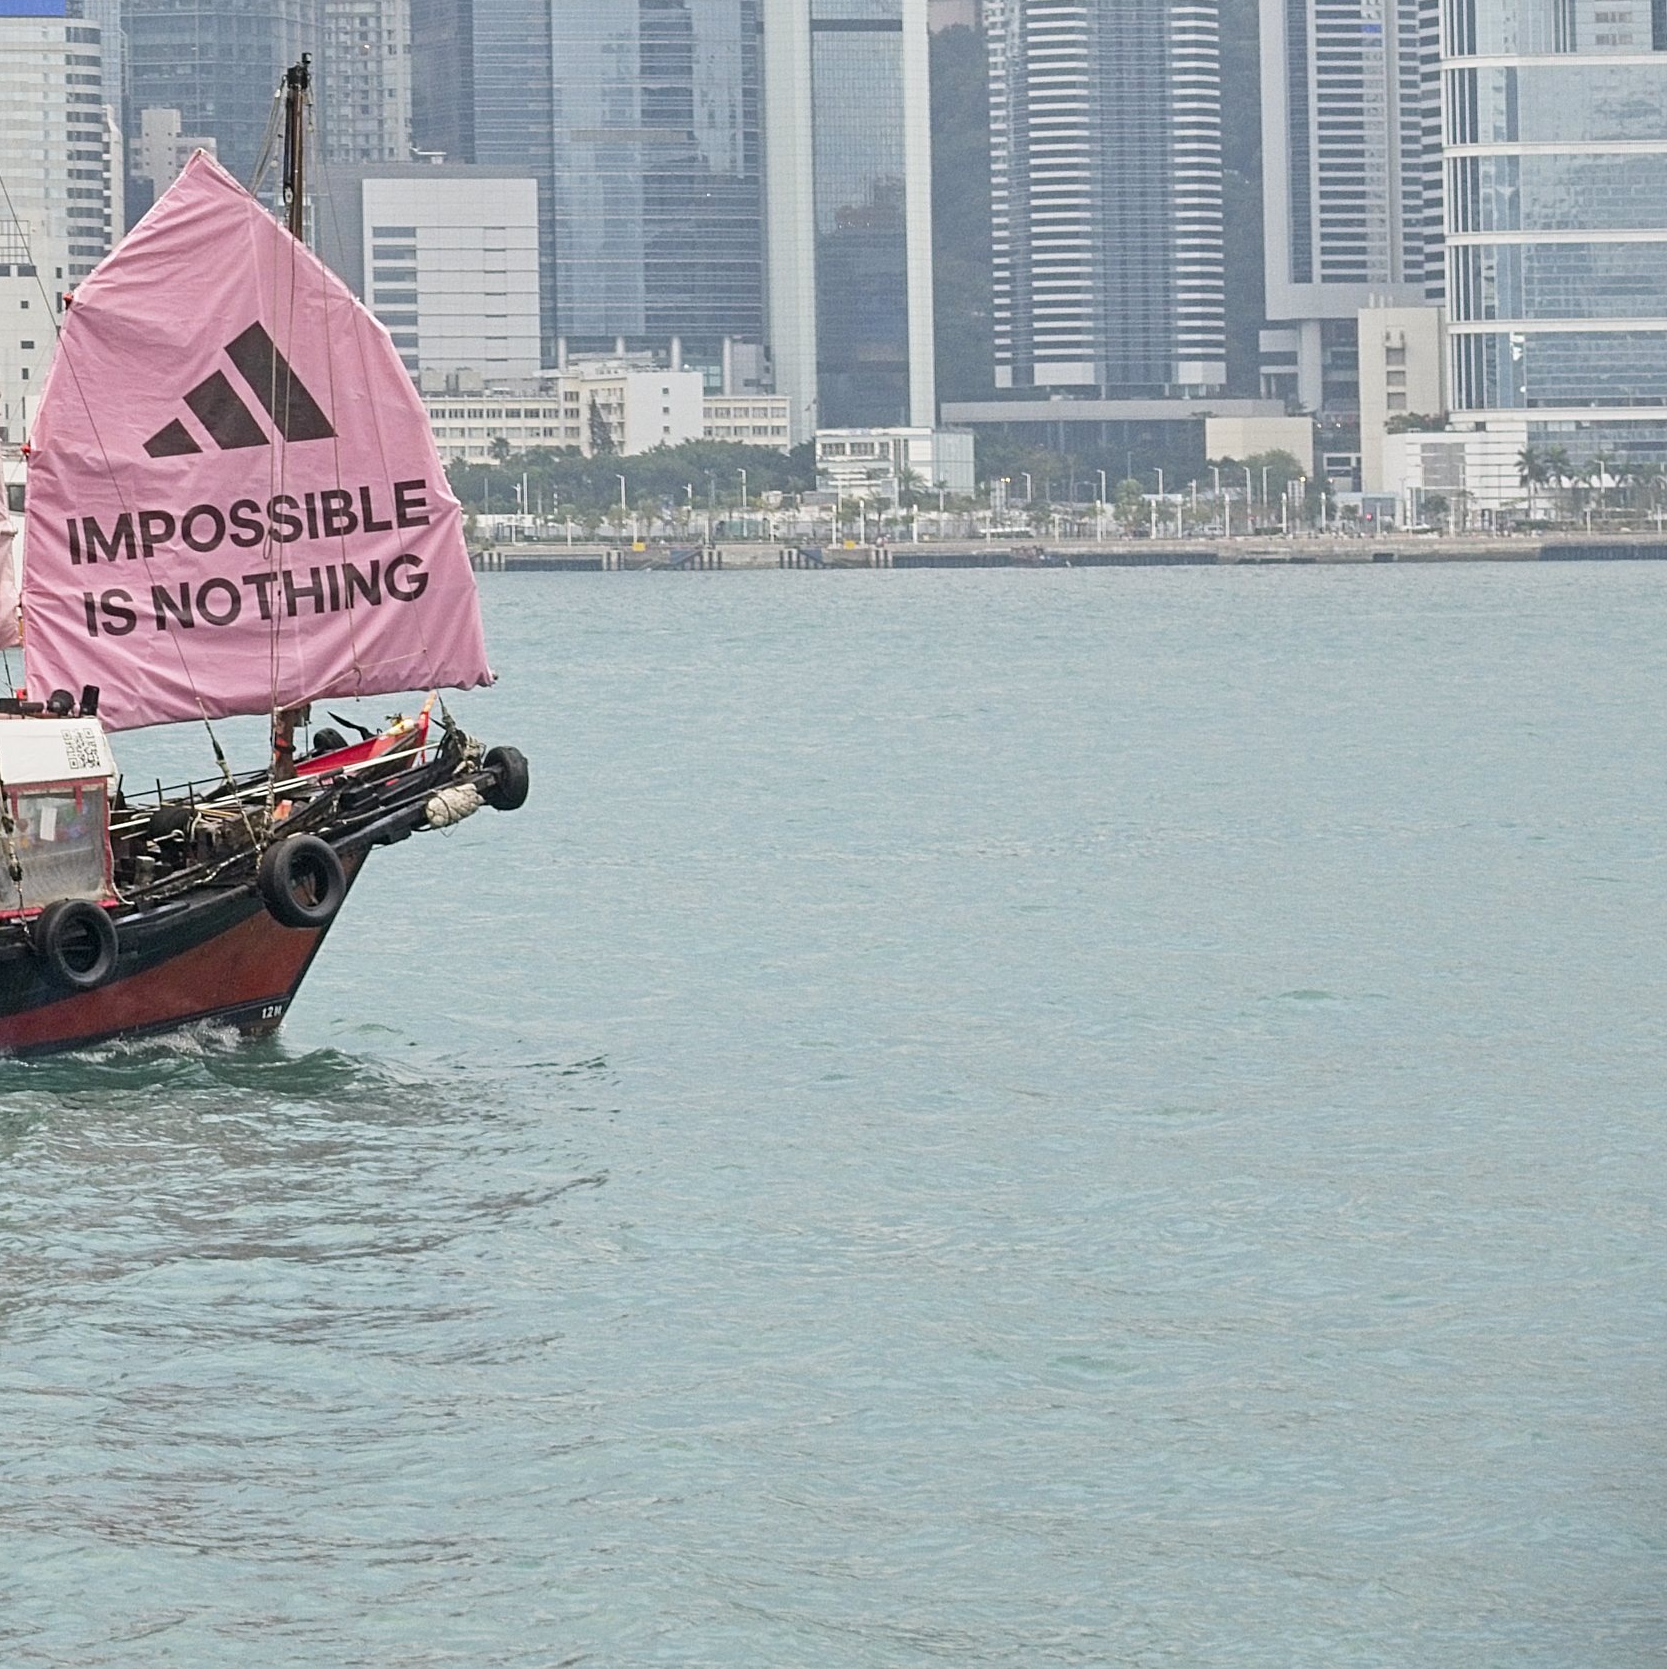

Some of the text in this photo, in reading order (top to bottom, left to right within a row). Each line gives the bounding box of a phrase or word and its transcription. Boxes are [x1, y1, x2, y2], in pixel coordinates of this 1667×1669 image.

[66, 479, 430, 565] IMPOSSIBLE
[83, 553, 429, 637] IS NOTHING
